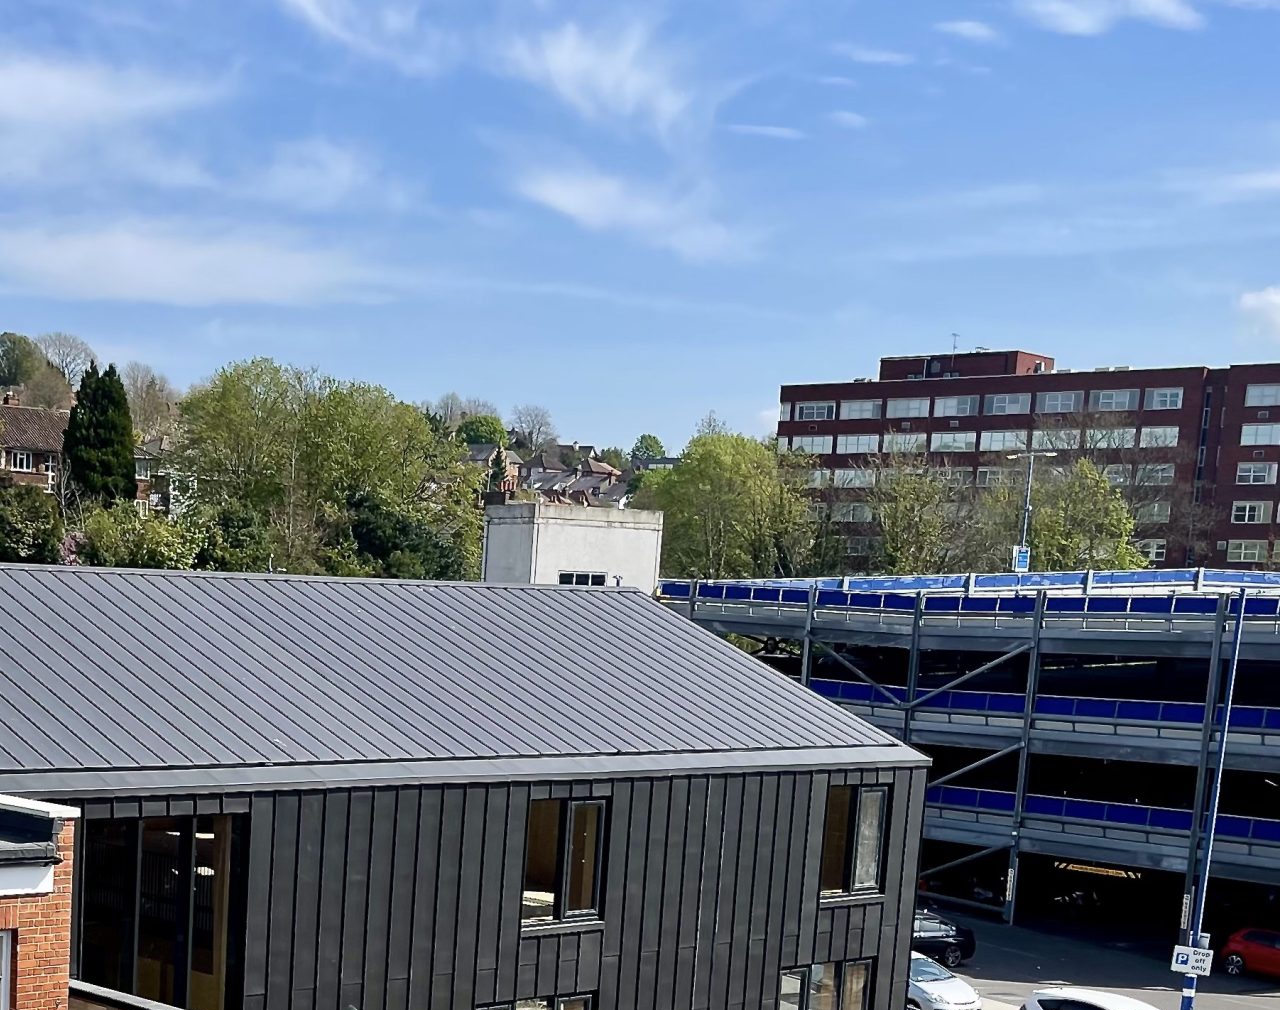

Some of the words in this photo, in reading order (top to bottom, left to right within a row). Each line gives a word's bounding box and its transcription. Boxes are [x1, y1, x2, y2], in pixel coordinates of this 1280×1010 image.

[1193, 950, 1210, 958] Drop
[1177, 953, 1188, 964] P
[1191, 965, 1207, 973] only
